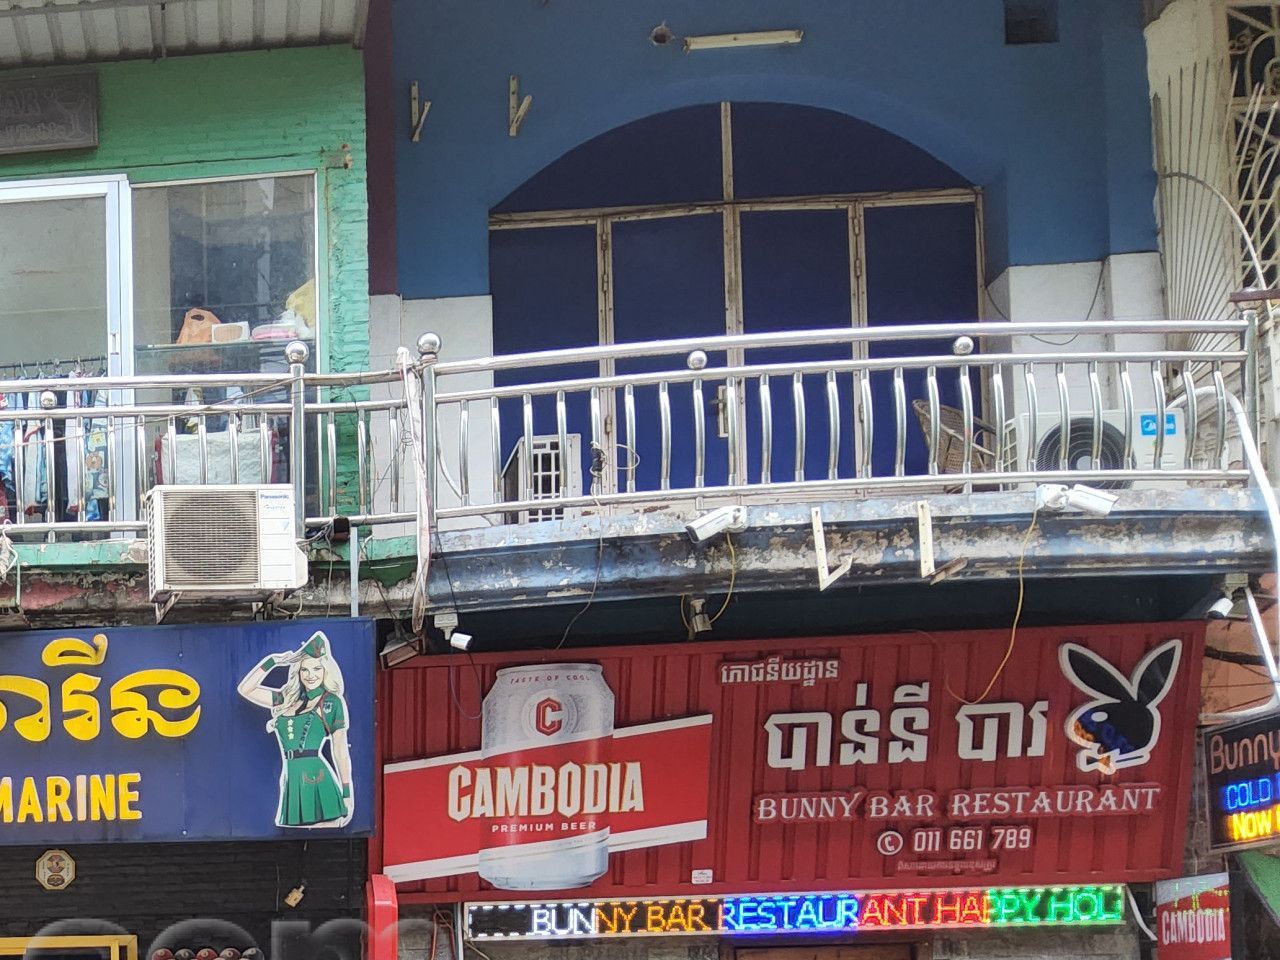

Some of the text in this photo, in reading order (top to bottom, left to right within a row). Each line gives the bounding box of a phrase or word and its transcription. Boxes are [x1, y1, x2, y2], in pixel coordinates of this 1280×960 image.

[955, 700, 1049, 762] បារ
[1210, 729, 1280, 775] Bunny
[447, 760, 645, 822] CAMBODIA
[757, 787, 1161, 819] BUNNY BAR RESTAURANT
[1227, 778, 1271, 811] COLD
[492, 821, 597, 833] PREMIUM BEER
[913, 828, 1031, 852] 011 661 789
[1231, 808, 1272, 840] NOW
[533, 903, 638, 934] BUNNY
[647, 902, 712, 932] BAR
[718, 896, 925, 931] RESTAURANT
[937, 891, 1041, 926] HAPPY
[1162, 907, 1226, 946] CAMBODIA
